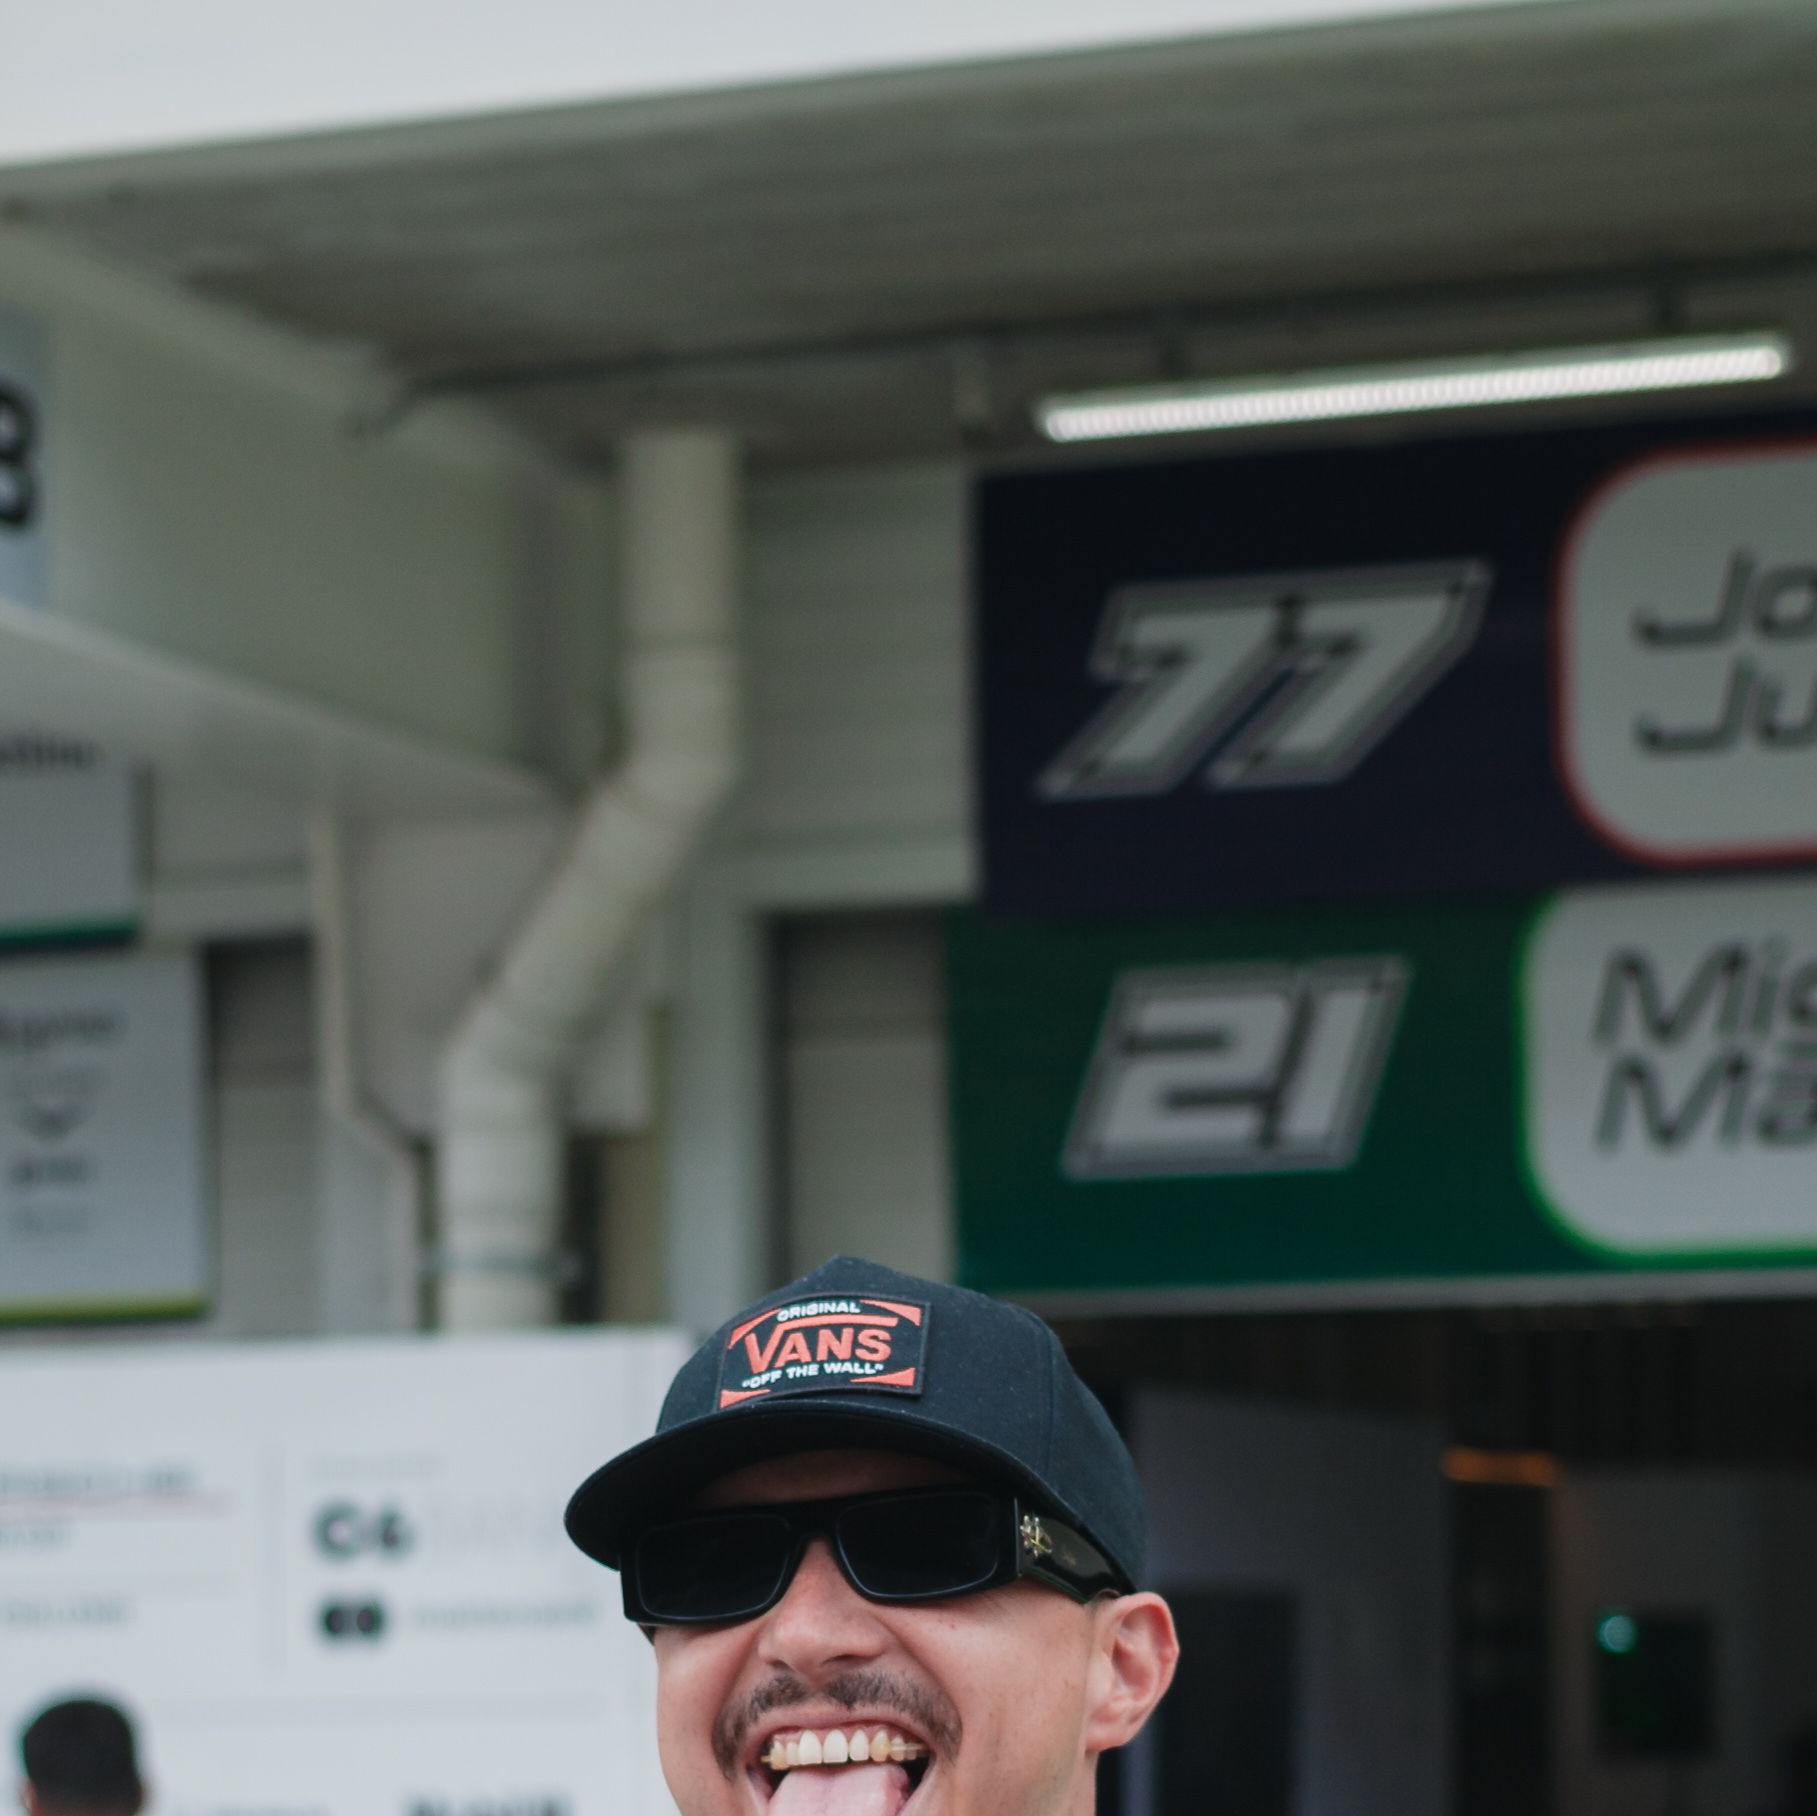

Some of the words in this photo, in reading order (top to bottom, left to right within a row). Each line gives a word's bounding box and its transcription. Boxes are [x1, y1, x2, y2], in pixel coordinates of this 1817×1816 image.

[1035, 560, 1492, 798] 77
[1062, 957, 1409, 1179] 21
[776, 1300, 861, 1323] ORIGINAL
[741, 1369, 783, 1389] "OFF
[786, 1363, 819, 1380] THE
[822, 1359, 885, 1376] WALL"
[743, 1314, 899, 1375] VANS
